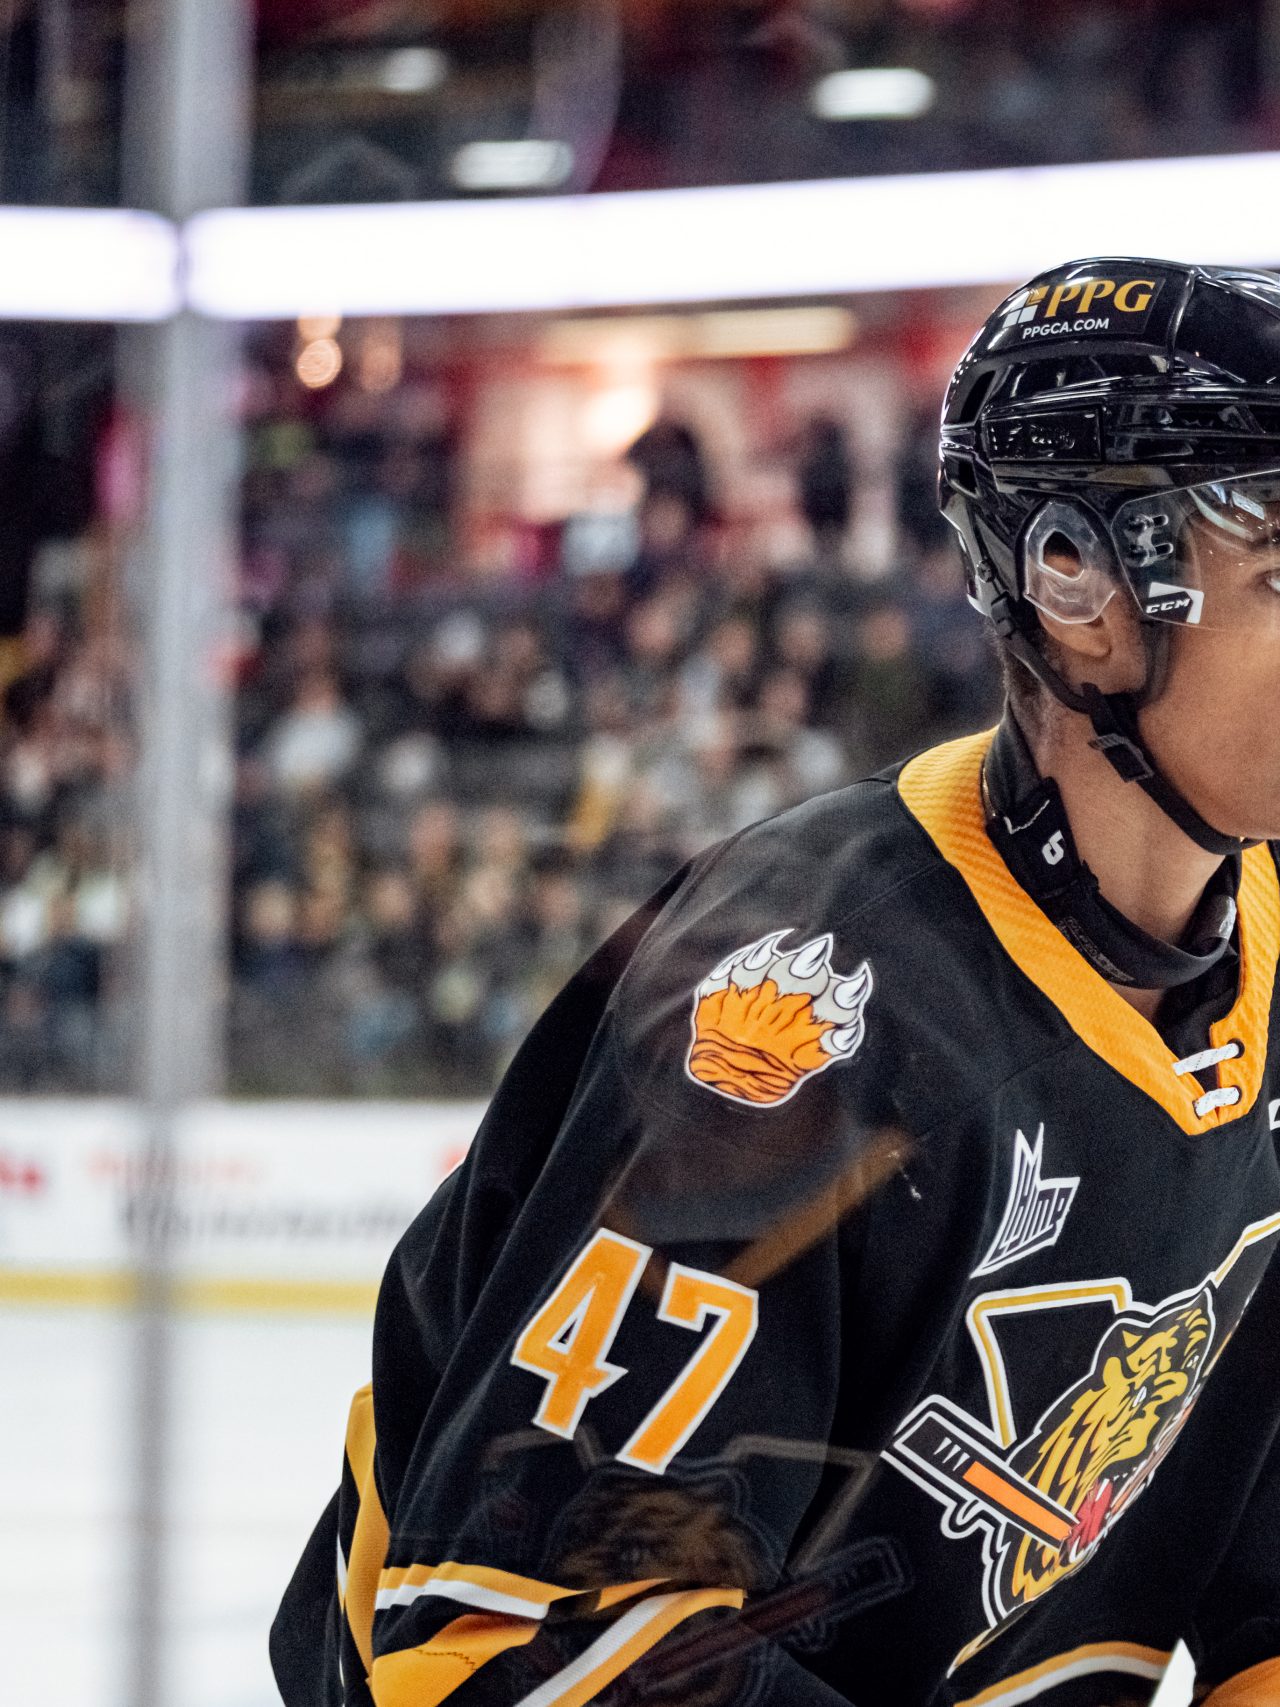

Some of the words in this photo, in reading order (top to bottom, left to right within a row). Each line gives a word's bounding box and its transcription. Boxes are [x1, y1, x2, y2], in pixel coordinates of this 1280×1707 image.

[1044, 280, 1155, 318] PPG
[1022, 317, 1110, 339] PPGCA.COM
[1146, 598, 1191, 613] CCM
[510, 1227, 759, 1475] 47
